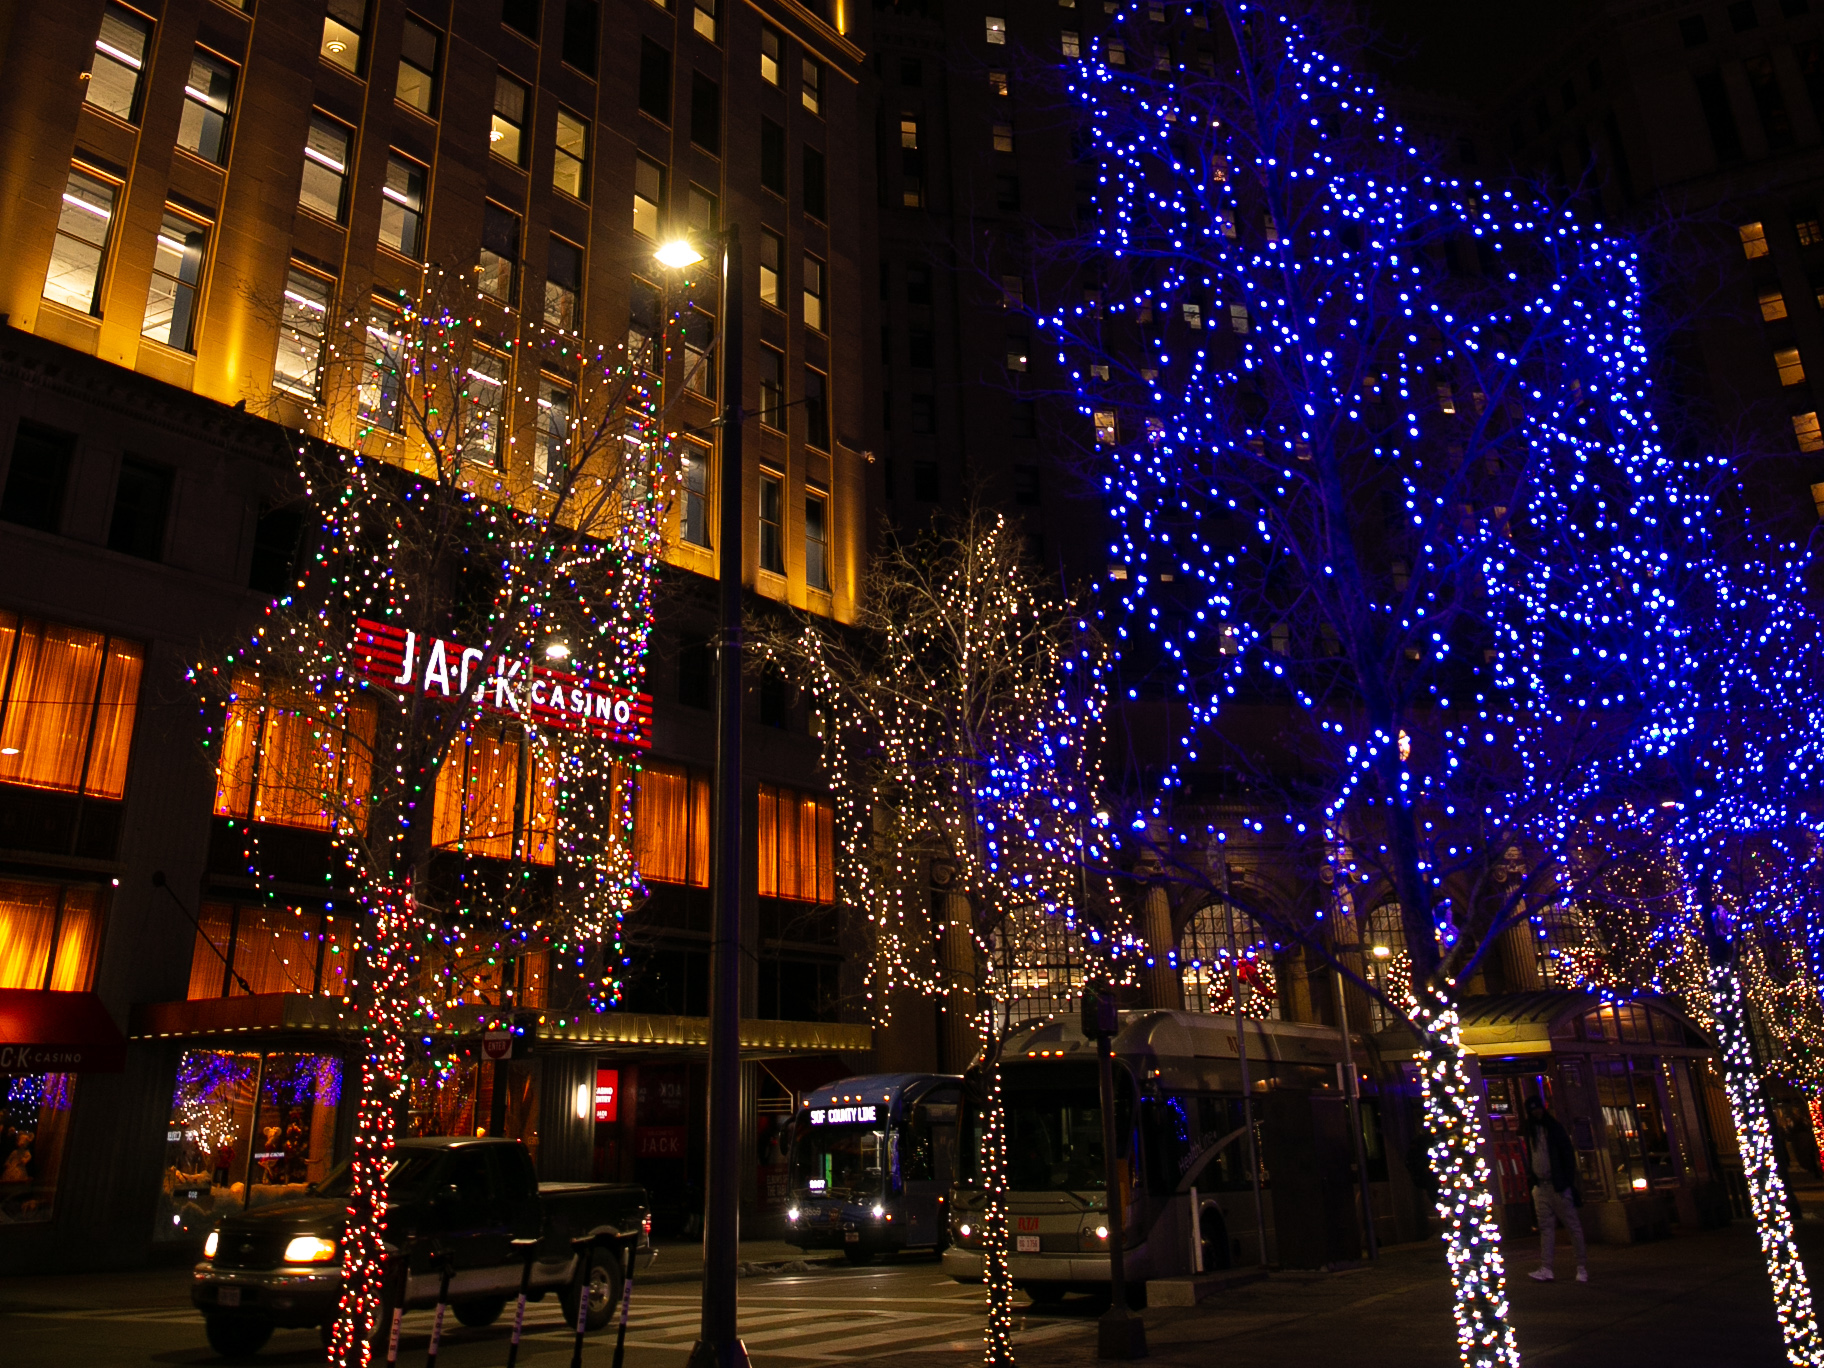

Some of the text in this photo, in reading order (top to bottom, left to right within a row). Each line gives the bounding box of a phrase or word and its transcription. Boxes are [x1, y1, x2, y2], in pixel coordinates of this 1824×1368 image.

[531, 679, 630, 724] CASINO
[488, 1041, 506, 1050] ENTER
[35, 1053, 82, 1063] CASINO
[828, 1108, 857, 1122] COUNTY
[858, 1106, 876, 1121] LINE
[641, 1137, 678, 1153] JACK
[579, 1294, 589, 1324] BIRD
[390, 1318, 400, 1351] BIRD
